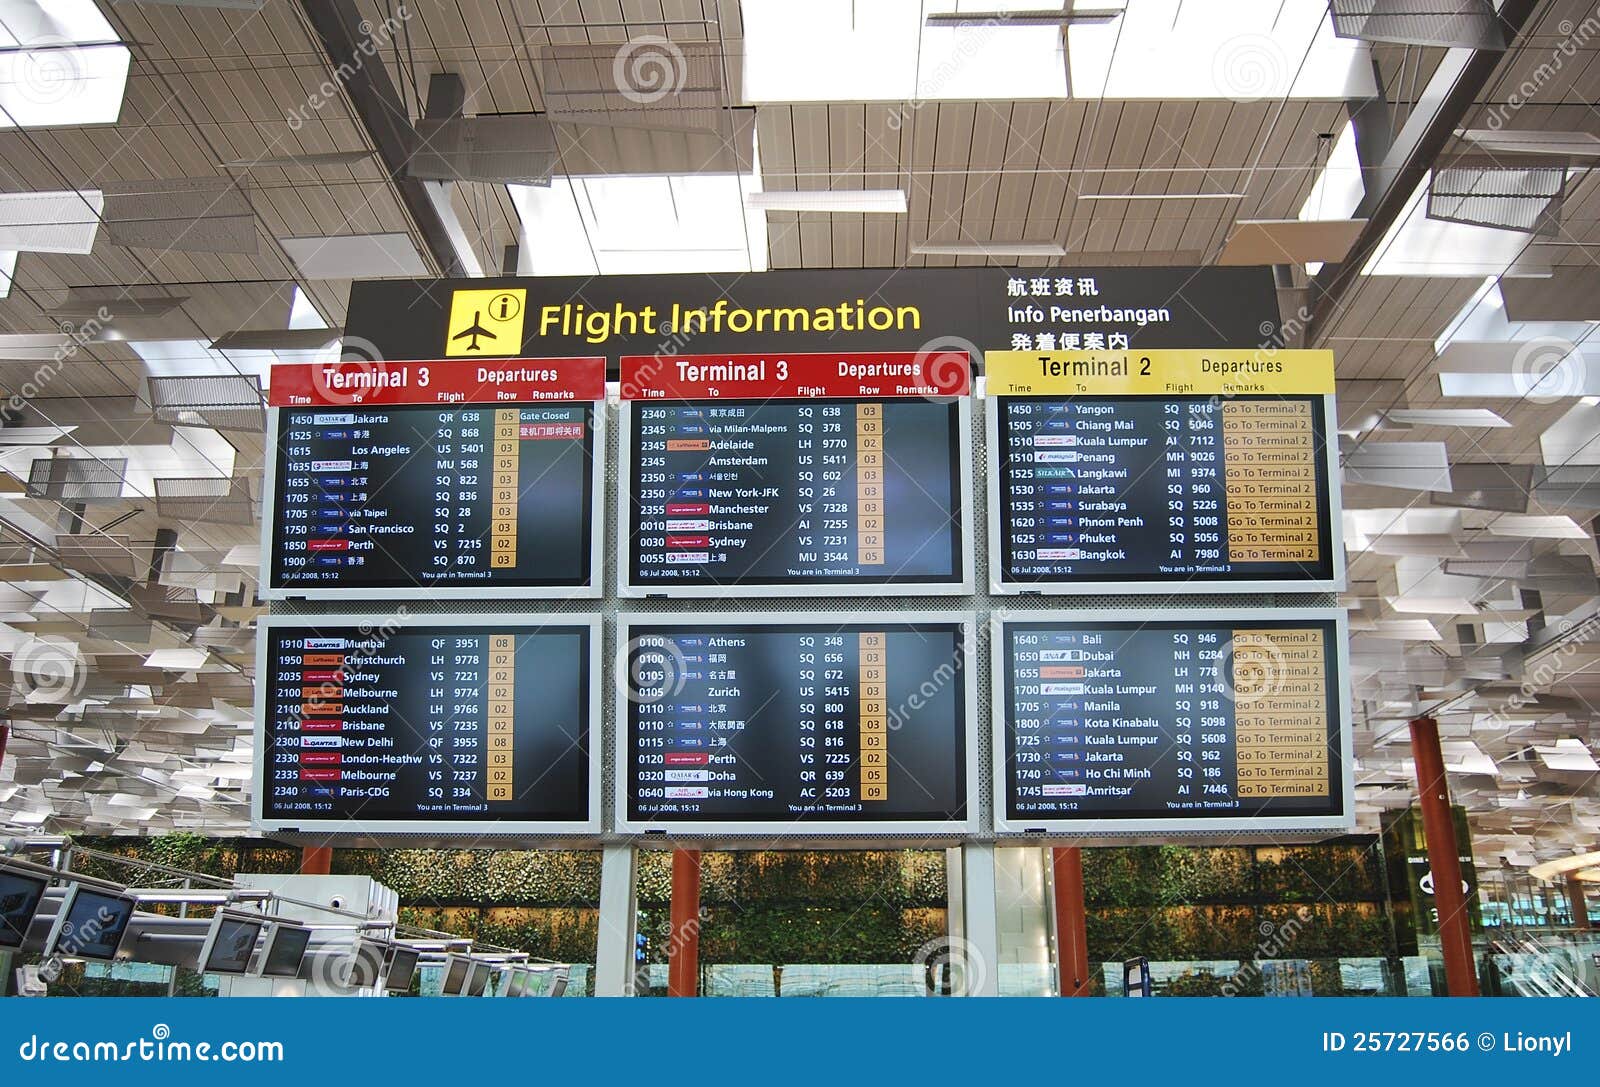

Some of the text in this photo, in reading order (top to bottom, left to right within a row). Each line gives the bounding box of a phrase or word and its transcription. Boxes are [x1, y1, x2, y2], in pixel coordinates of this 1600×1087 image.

[1007, 277, 1099, 297] 航班资讯
[539, 299, 921, 344] Flight Information
[1008, 305, 1169, 326] Info Penerbangan
[676, 360, 921, 382] Terminal 3 Departures
[1038, 357, 1282, 376] Terminal 2 Departures
[323, 367, 557, 389] Terminal 3 Departures
[642, 385, 939, 397] Time To Flight Row Remarks
[1008, 383, 1265, 393] Time To Flight Remarks
[289, 390, 574, 404] Time To Flight Row Remarks
[291, 416, 313, 425] 1450
[352, 414, 388, 424] Jakarta
[439, 413, 453, 424] QR
[462, 413, 480, 422] 638
[502, 412, 513, 421] 05
[520, 412, 540, 420] Gate
[541, 411, 570, 420] Closed
[642, 409, 666, 419] 2340
[798, 408, 813, 418] SQ
[822, 407, 841, 416] 638
[863, 407, 875, 416] 03
[290, 431, 311, 440] 1525
[353, 430, 370, 439] 香港
[438, 429, 452, 439] SQ
[461, 428, 479, 437] 868
[501, 428, 513, 437] 03
[289, 443, 512, 456] 1615 Los Angeles US 5401 03
[641, 455, 876, 466] 2345 Amsterdam US 5411 03
[1009, 453, 1033, 462] 1510
[1075, 451, 1115, 464] Penang
[1166, 452, 1184, 461] MH
[1190, 452, 1215, 461] 9026
[1225, 452, 1239, 461] Go
[1244, 452, 1254, 461] To
[1258, 452, 1299, 461] Terminal
[1303, 452, 1308, 461] 2
[641, 473, 665, 482] 2350
[799, 471, 813, 482] SQ
[823, 471, 841, 480] 602
[864, 471, 876, 480] 03
[1009, 469, 1034, 478] 1525
[1077, 468, 1127, 480] Langkawi
[1167, 468, 1180, 477] MI
[1191, 468, 1216, 477] 9374
[1226, 468, 1240, 477] Go
[1244, 468, 1255, 477] To
[1259, 468, 1300, 477] Terminal
[1304, 468, 1309, 477] 2
[640, 505, 665, 515] 2355
[709, 504, 769, 514] Manchester
[798, 504, 812, 513] VS
[823, 503, 848, 512] 7328
[864, 503, 877, 512] 03
[280, 639, 303, 648] 1910
[344, 638, 385, 649] Mumbai
[432, 639, 445, 649] QF
[455, 639, 478, 648] 3951
[496, 639, 508, 648] 08
[639, 686, 879, 697] 0105 Zurich US 5415 03
[1015, 702, 1039, 712] 1705
[1084, 701, 1120, 711] Manila
[1175, 700, 1191, 711] SQ
[1200, 700, 1219, 710] 918
[1235, 701, 1250, 710] Go
[1254, 700, 1265, 709] To
[1268, 700, 1311, 709] Terminal
[1315, 700, 1320, 709] 2
[276, 737, 299, 746] 2300
[342, 737, 364, 747] New
[367, 737, 393, 747] Delhi
[429, 737, 443, 748] QF
[453, 737, 478, 747] 3955
[494, 738, 506, 747] 08
[275, 753, 506, 764] 2330 London-Heathw VS 7322 03
[638, 754, 664, 764] 0120
[708, 754, 736, 764] Perth
[800, 754, 814, 763] VS
[825, 754, 850, 763] 7225
[867, 754, 880, 763] 02
[638, 771, 663, 781] 0320
[708, 771, 736, 780] Doha
[800, 771, 816, 782] QR
[825, 771, 844, 780] 639
[867, 770, 880, 780] 05
[1016, 766, 1323, 779] 1740 Ho Chi Minh SQ 186 Go To Terminal 2
[659, 804, 679, 812] 2008,
